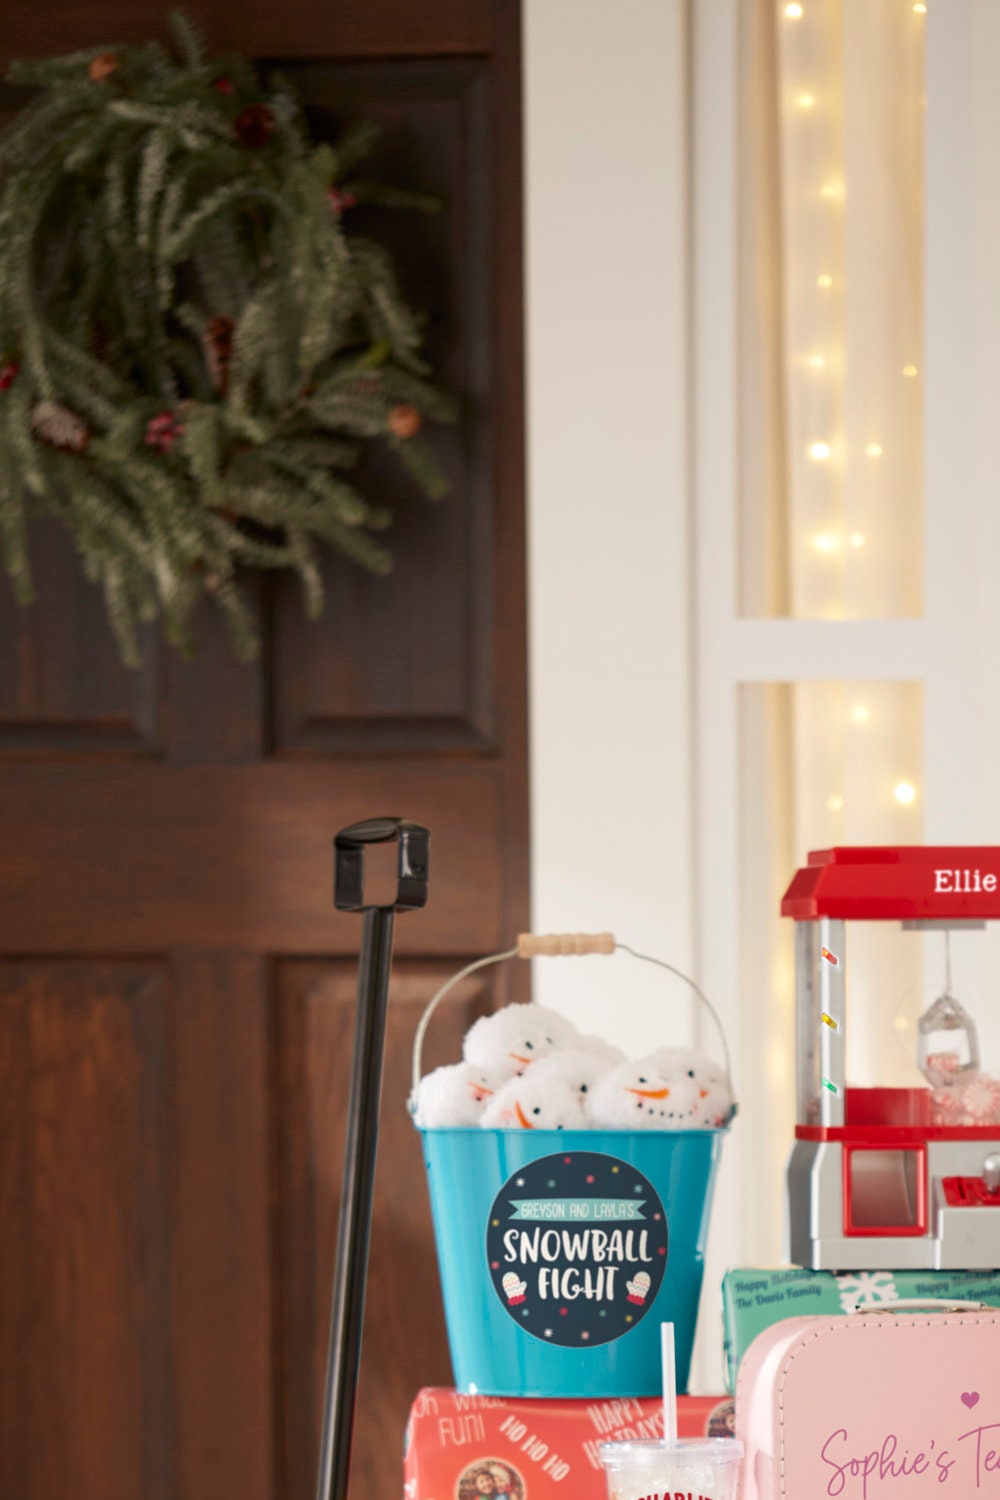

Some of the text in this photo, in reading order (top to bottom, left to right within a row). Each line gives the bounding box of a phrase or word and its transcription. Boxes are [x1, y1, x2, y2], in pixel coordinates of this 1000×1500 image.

[934, 870, 997, 892] Ellie
[520, 1202, 635, 1218] GREYSON AND LAYLA'S
[503, 1226, 653, 1264] SNOWBALL
[538, 1266, 620, 1301] FIGHT
[498, 1415, 527, 1442] HO
[519, 1435, 549, 1462] HO
[541, 1454, 570, 1481] HO
[821, 1428, 956, 1500] Sophie's
